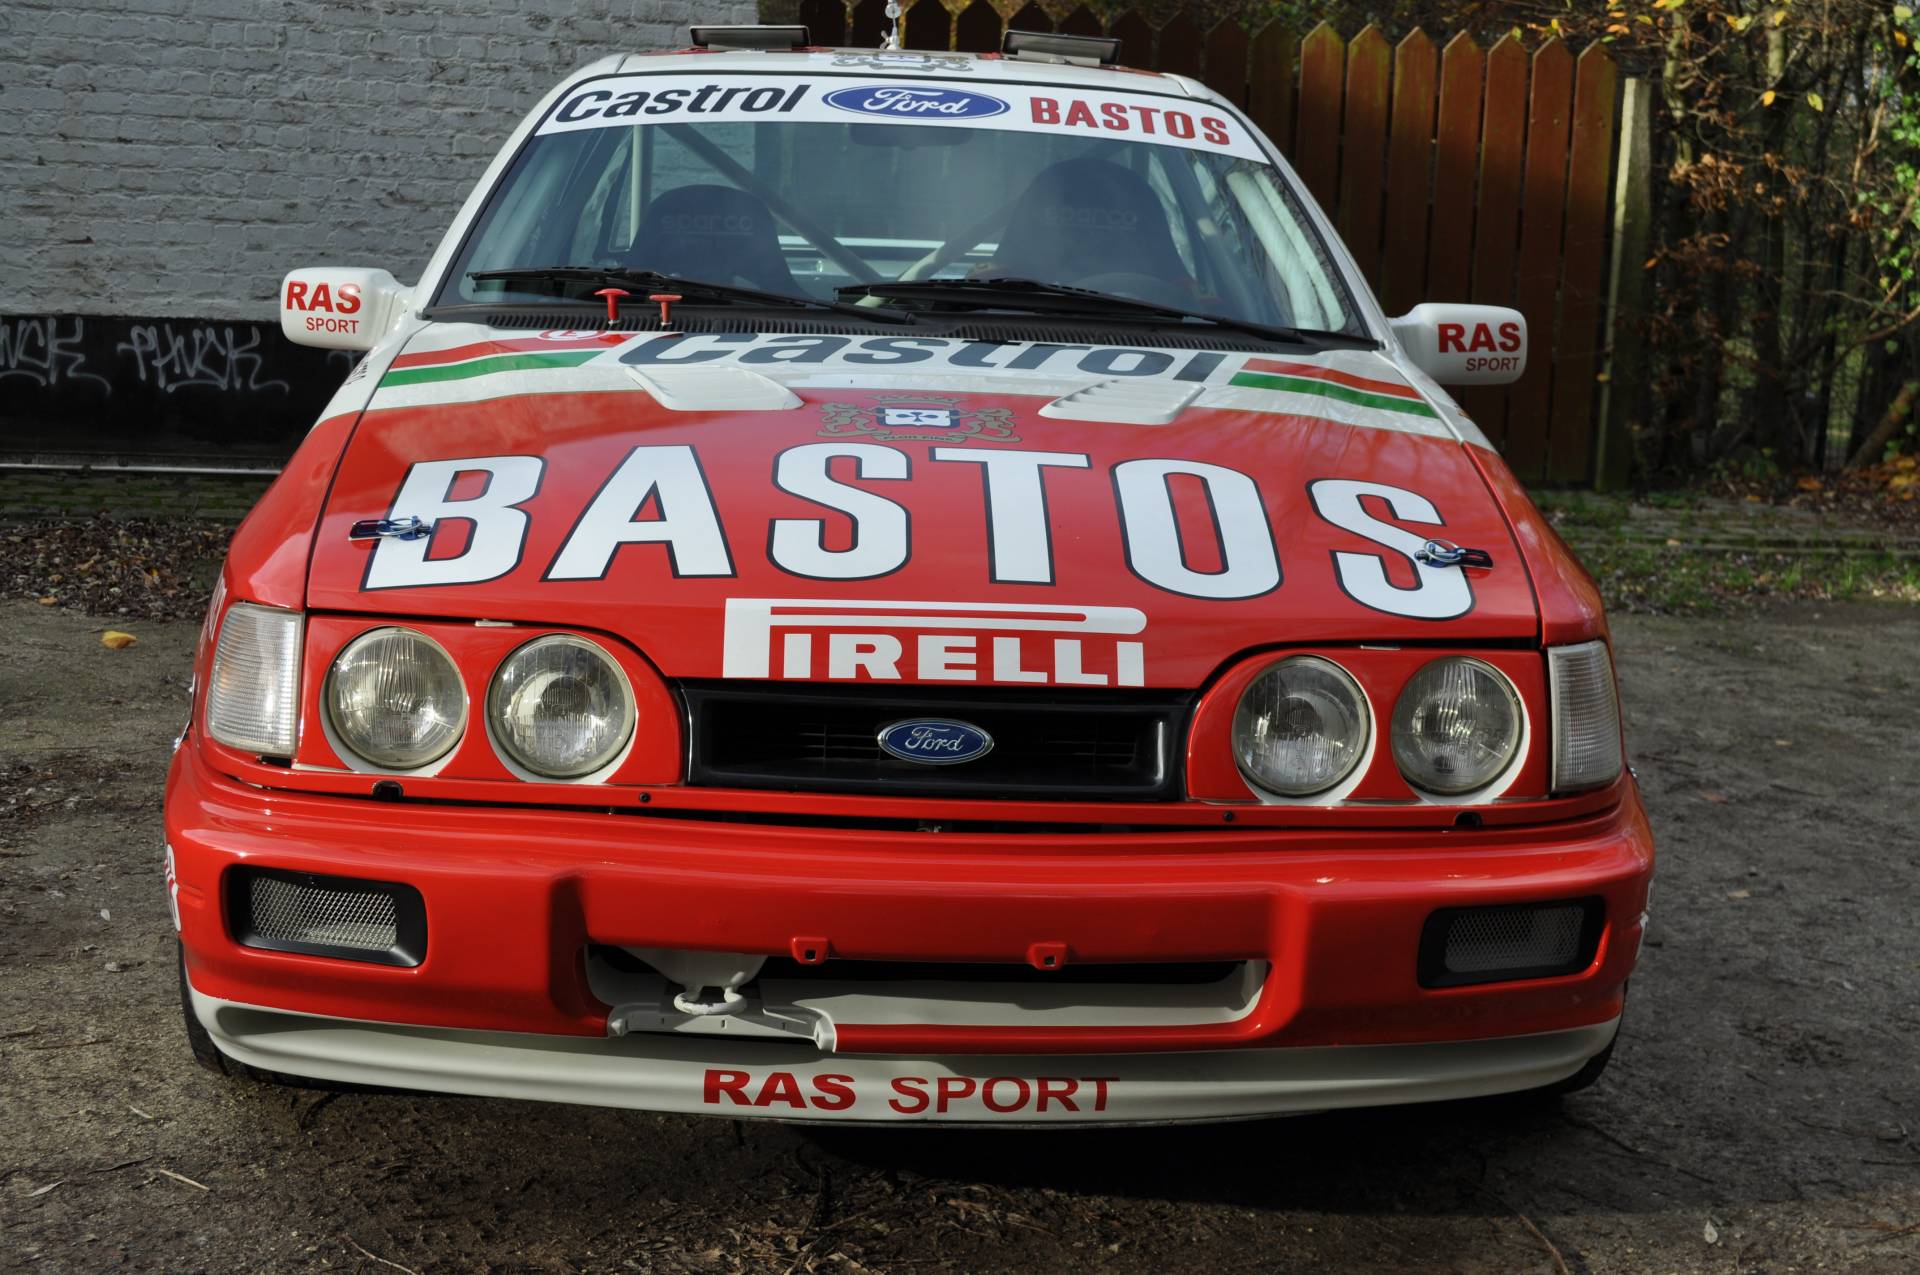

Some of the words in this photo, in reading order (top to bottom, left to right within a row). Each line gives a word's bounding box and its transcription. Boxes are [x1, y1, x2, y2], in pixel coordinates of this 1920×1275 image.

[555, 84, 811, 123] Castrol
[862, 86, 969, 116] Ford
[1029, 96, 1231, 146] BASTOS
[286, 281, 362, 315] RAS
[305, 316, 360, 335] SPORT
[1437, 321, 1522, 354] RAS
[619, 333, 1229, 382] Castrol
[1464, 356, 1521, 373] SPORT
[359, 442, 1475, 622] BASTOS
[722, 598, 1148, 688] PIRELLI
[904, 726, 966, 751] Ford
[703, 1068, 857, 1112] RAS
[887, 1076, 1121, 1114] SPORT
